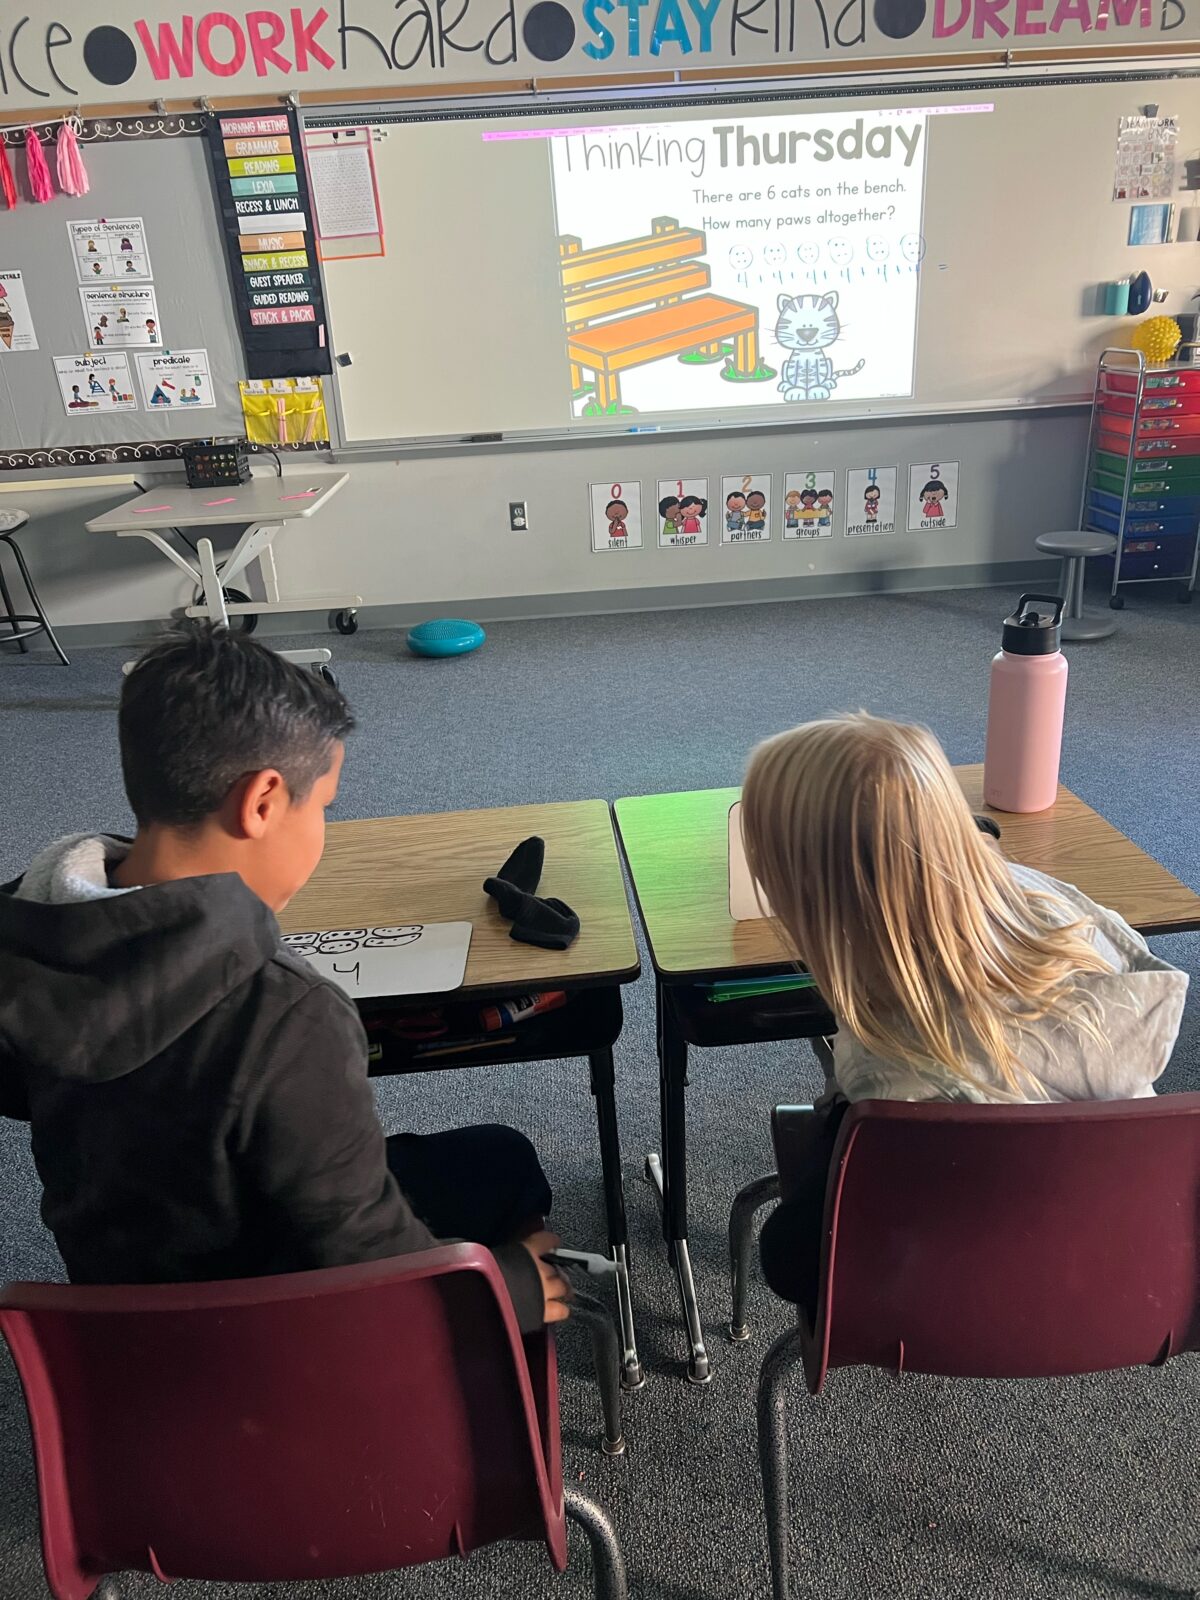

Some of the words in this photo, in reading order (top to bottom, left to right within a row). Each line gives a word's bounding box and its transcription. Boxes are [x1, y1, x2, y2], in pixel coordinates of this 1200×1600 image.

[134, 7, 336, 81] WORK
[581, 0, 722, 61] STAY
[932, 0, 1152, 39] DREAM
[222, 121, 256, 134] MORNING
[257, 119, 287, 132] MEETING
[235, 140, 280, 155] GRAMMAR
[555, 130, 705, 178] Thinking
[712, 118, 923, 168] Thursday
[244, 159, 280, 175] READING
[252, 180, 276, 194] LEXIA
[692, 189, 733, 204] There
[738, 191, 762, 201] are
[767, 185, 776, 200] 6
[781, 185, 811, 199] cats
[815, 187, 832, 197] on
[836, 181, 859, 195] the
[864, 178, 907, 195] bench.
[235, 200, 264, 214] RECESS
[265, 199, 272, 212] &
[273, 198, 299, 211] LUNCH
[702, 216, 731, 231] How
[736, 216, 772, 231] many
[776, 216, 811, 229] paws
[816, 204, 896, 226] altogether?
[72, 225, 92, 234] Types
[102, 223, 140, 231] Sentences
[258, 236, 285, 251] MUSIC
[244, 257, 268, 271] SNACK
[271, 257, 278, 269] &
[279, 255, 306, 268] RECESS
[250, 275, 272, 288] GUEST
[273, 273, 305, 286] SPEAKER
[119, 290, 150, 298] structure
[253, 293, 278, 305] GUIDED
[279, 291, 309, 304] READING
[253, 311, 279, 325] STACK
[280, 310, 287, 322] &
[289, 308, 313, 322] PACK
[75, 356, 107, 367] subject
[153, 356, 191, 367] predicate
[868, 468, 877, 486] 4
[930, 464, 940, 480] 5
[741, 475, 752, 492] 2
[805, 472, 816, 489] 3
[676, 480, 685, 498] 1
[847, 522, 895, 535] presentation
[920, 517, 947, 529] outside
[669, 534, 697, 546] whisper
[730, 530, 762, 542] partners
[795, 528, 820, 538] groups
[608, 535, 628, 548] silent
[333, 961, 360, 985] 4
